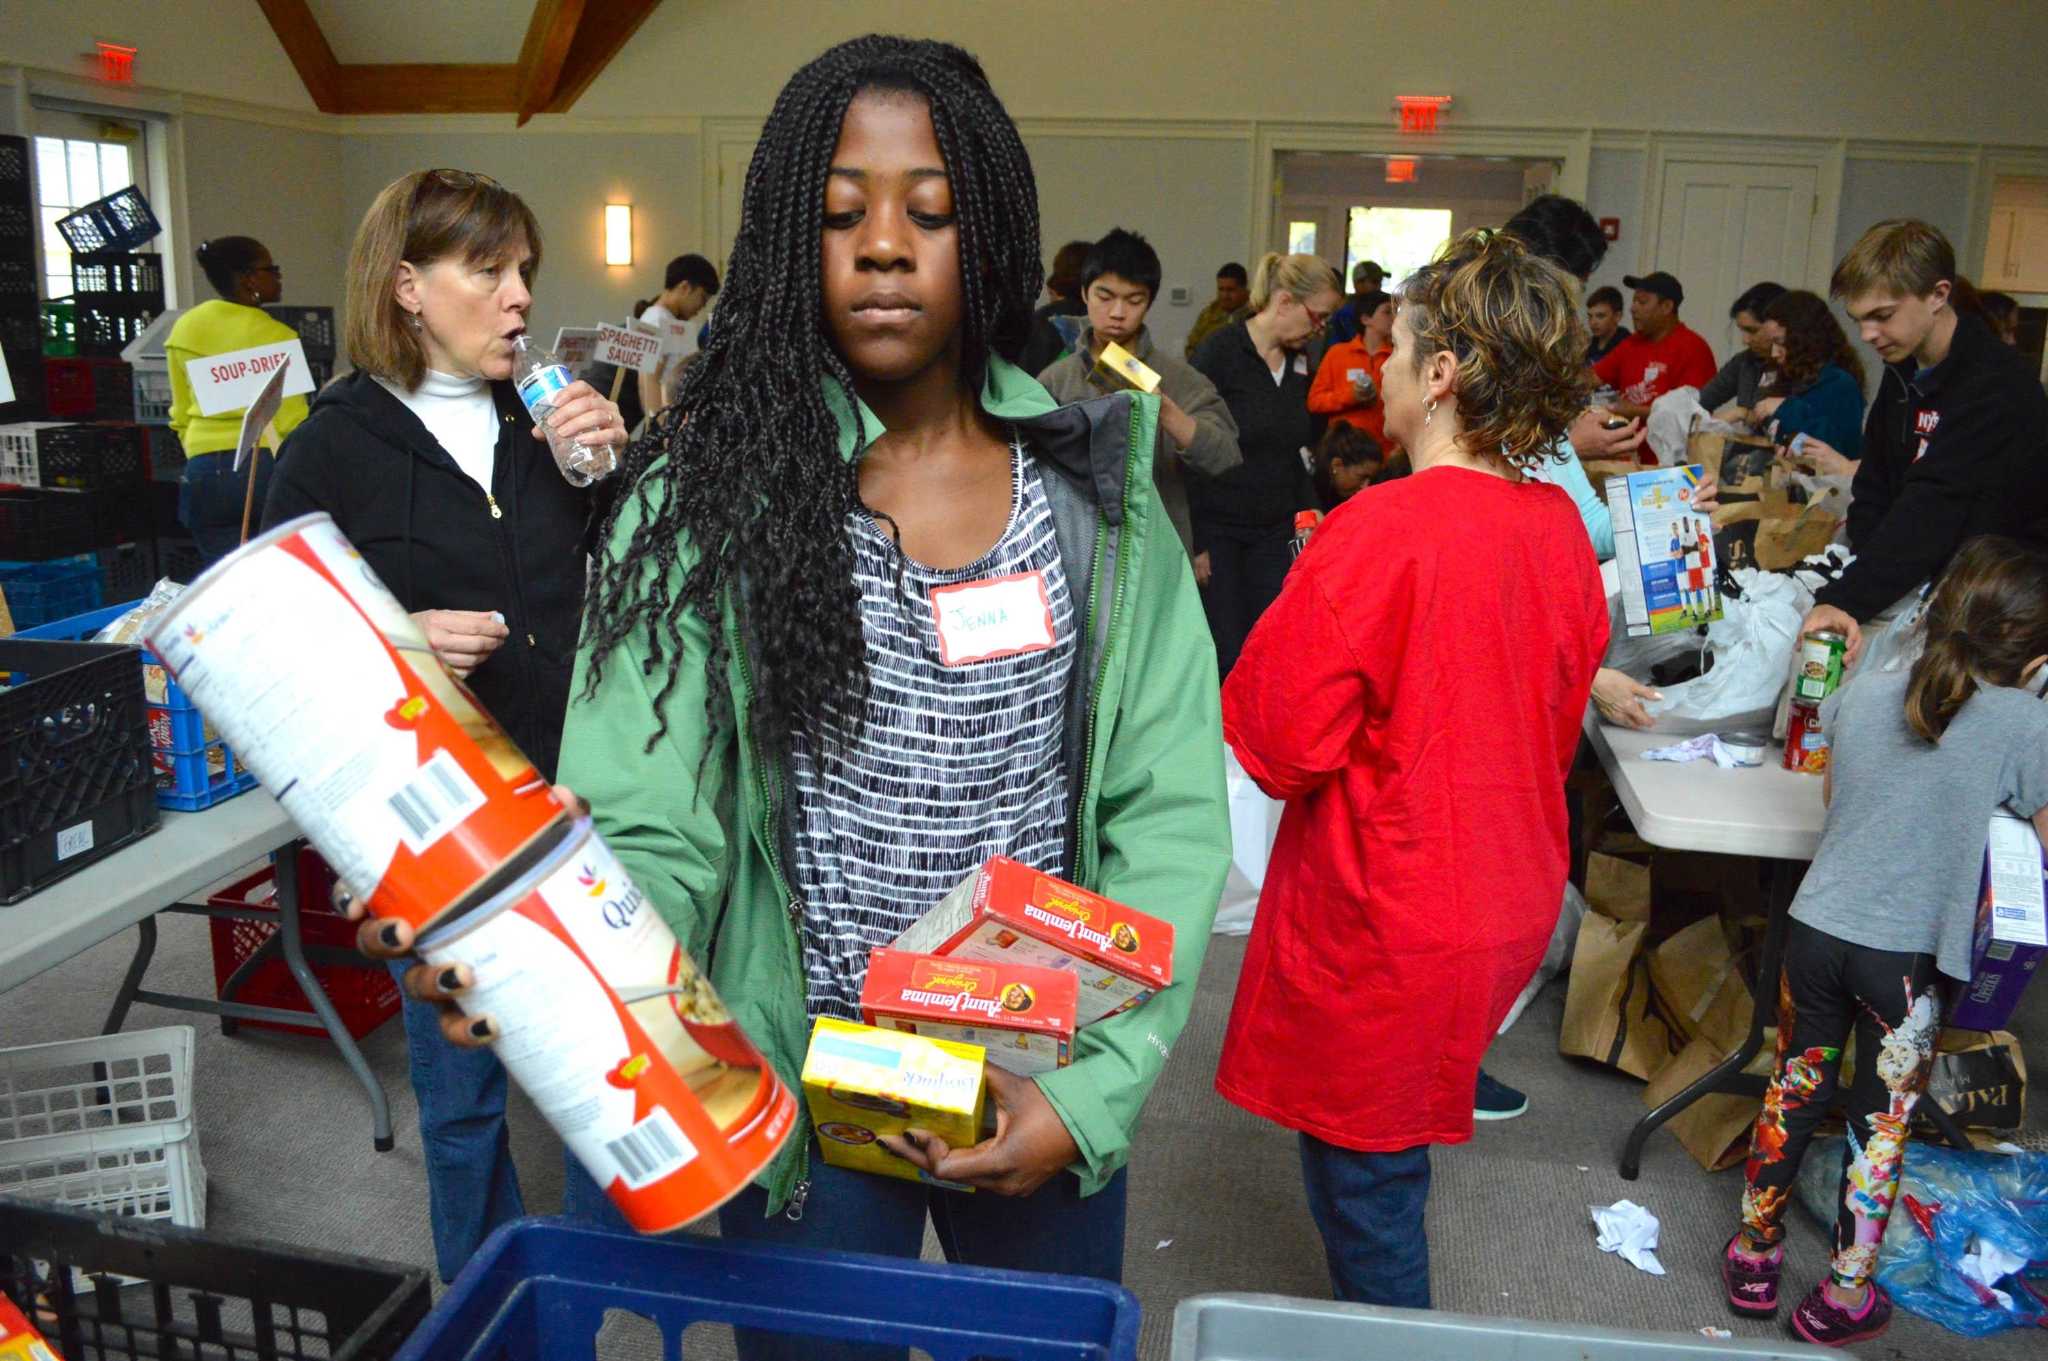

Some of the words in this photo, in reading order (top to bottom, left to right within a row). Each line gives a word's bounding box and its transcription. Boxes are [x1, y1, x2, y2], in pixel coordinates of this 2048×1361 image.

[600, 327, 658, 353] SPAGHETTI
[607, 346, 644, 367] SAUCE
[1024, 904, 1084, 939] Jemima
[1077, 925, 1114, 953] Aunt
[900, 989, 967, 1012] Jemima
[962, 997, 1003, 1018] Aunt
